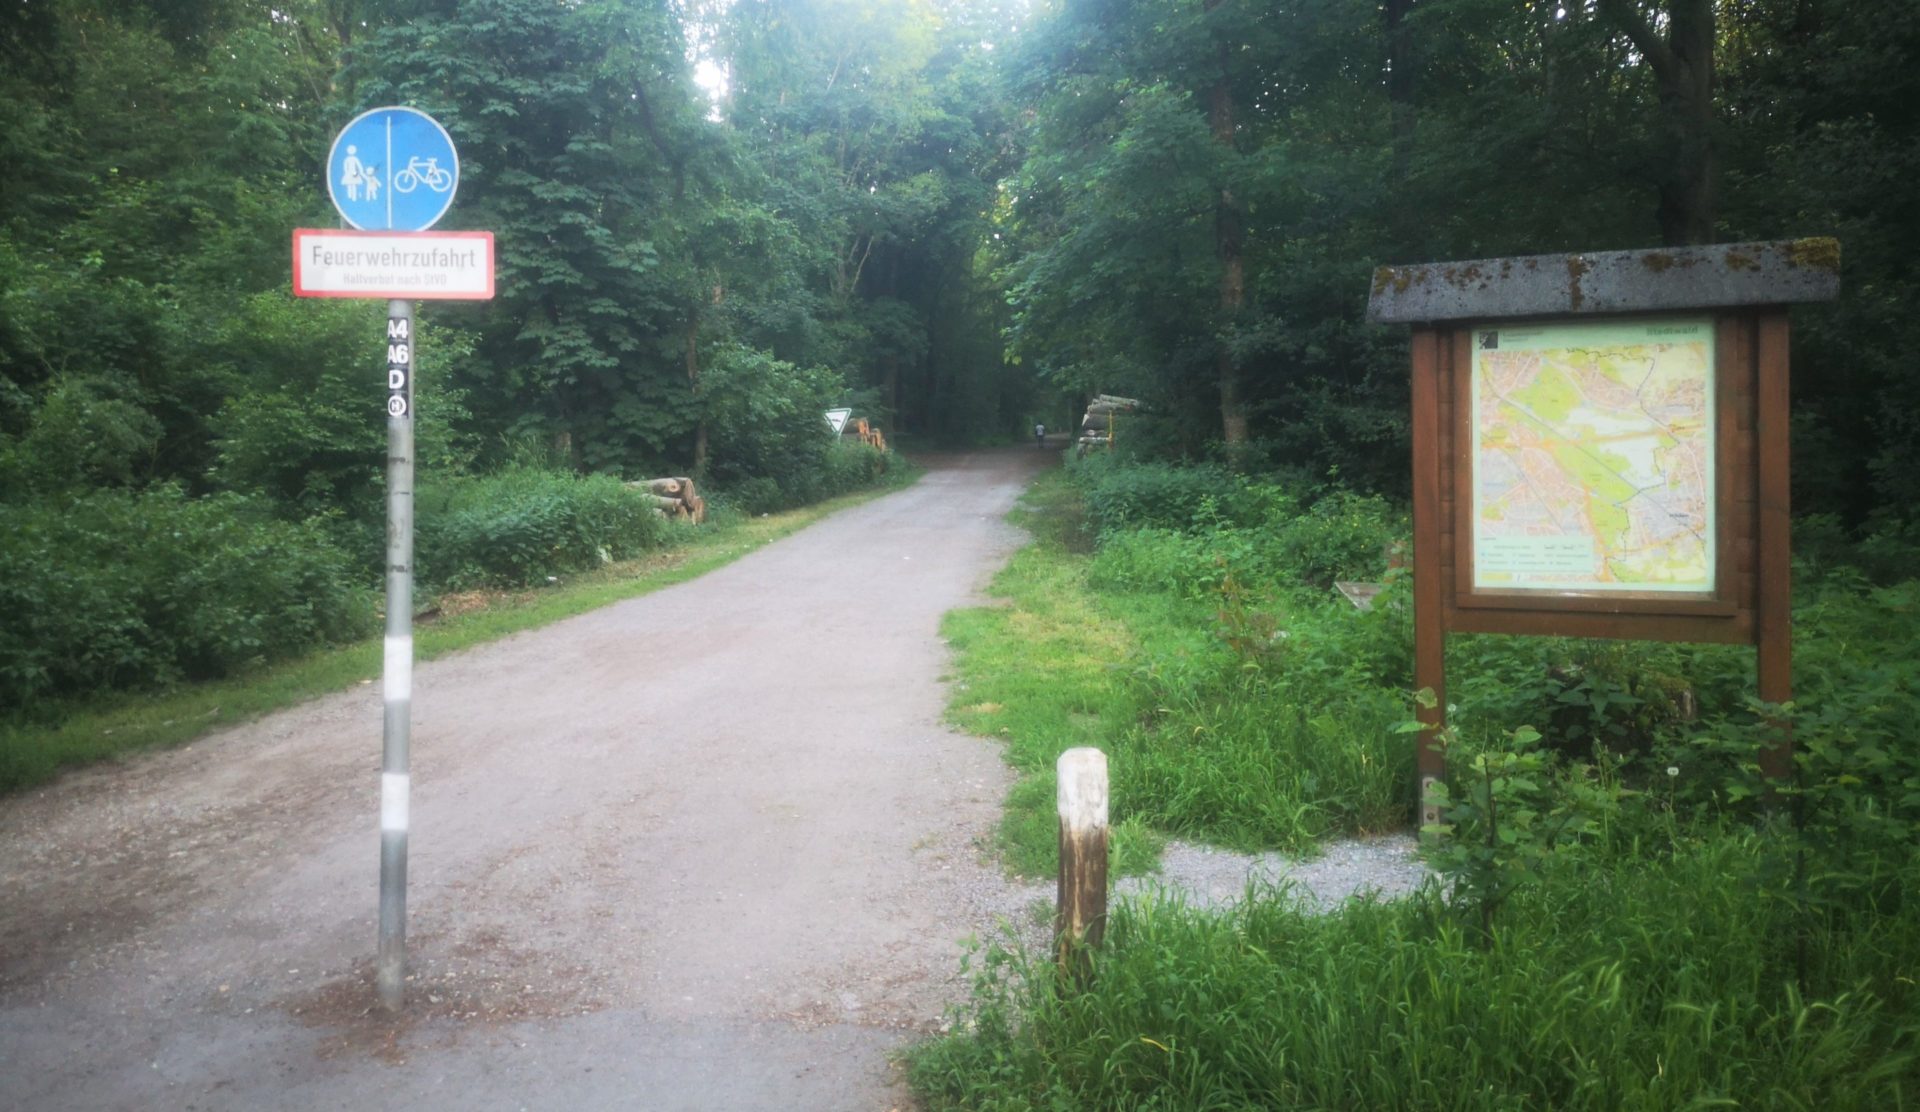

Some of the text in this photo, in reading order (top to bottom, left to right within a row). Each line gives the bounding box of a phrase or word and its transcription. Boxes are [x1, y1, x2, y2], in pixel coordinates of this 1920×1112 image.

[312, 245, 476, 268] Feuerwehrzufahrt
[399, 273, 422, 285] nach
[388, 319, 408, 339] A4
[388, 344, 409, 364] A6
[389, 369, 405, 389] D
